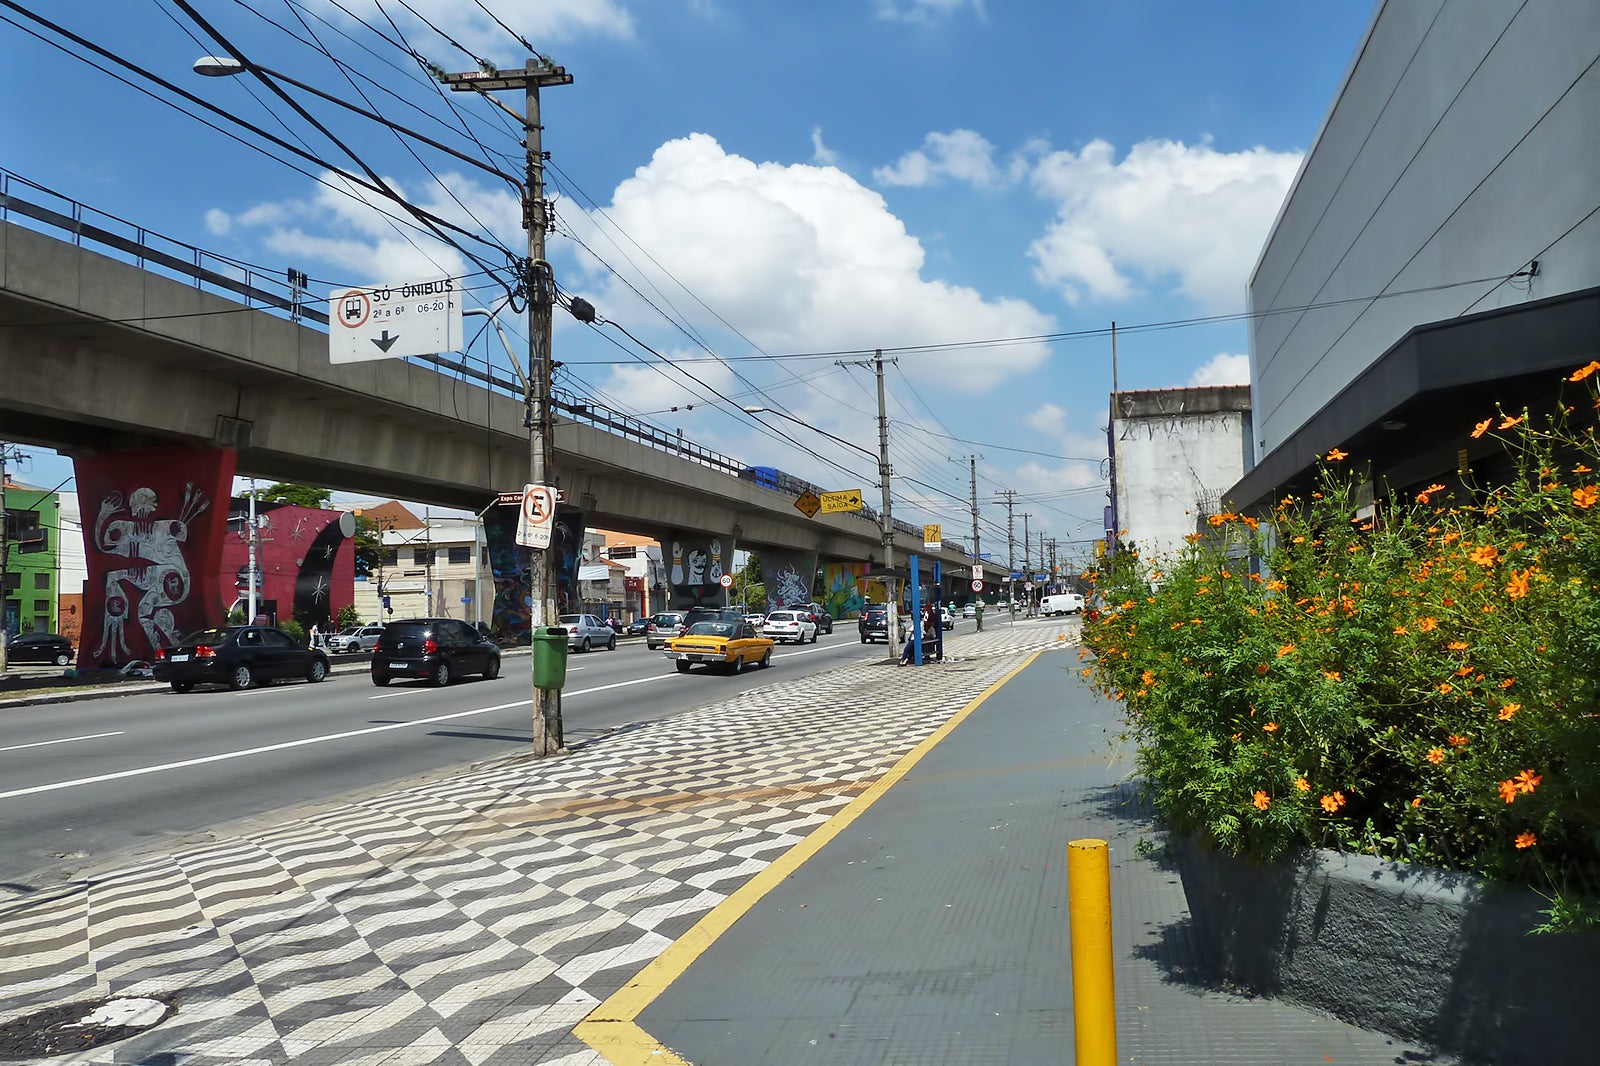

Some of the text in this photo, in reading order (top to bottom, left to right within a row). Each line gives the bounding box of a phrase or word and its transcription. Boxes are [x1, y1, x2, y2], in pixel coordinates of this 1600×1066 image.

[373, 280, 453, 302] SÓ ÔNIBUS
[417, 302, 444, 313] 06-20
